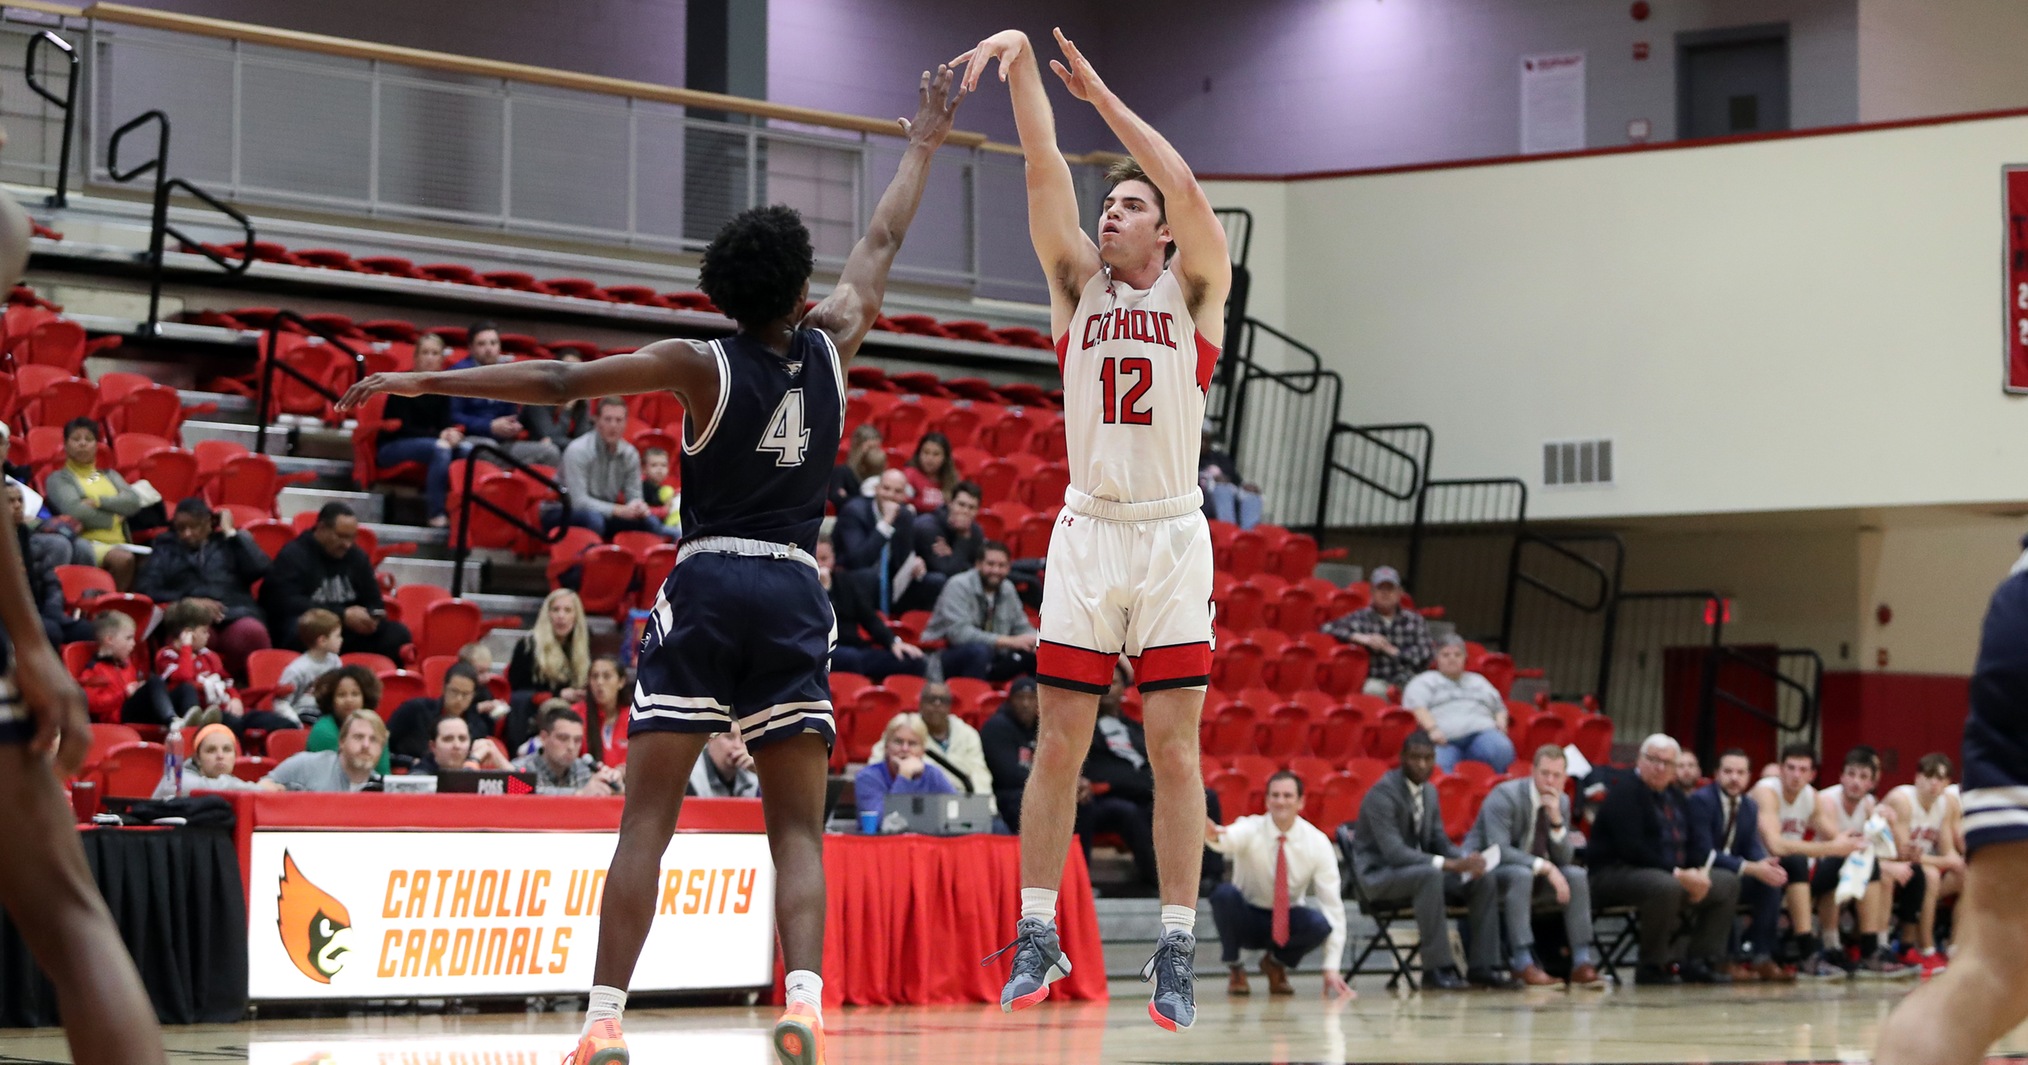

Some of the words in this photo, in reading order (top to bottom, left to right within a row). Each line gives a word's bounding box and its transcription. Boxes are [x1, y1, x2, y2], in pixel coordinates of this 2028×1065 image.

[1099, 357, 1153, 425] 12
[755, 387, 811, 467] 4
[382, 869, 551, 918] CATHOLIC
[564, 868, 756, 917] UNRSITY
[377, 927, 572, 978] CARDINALS
